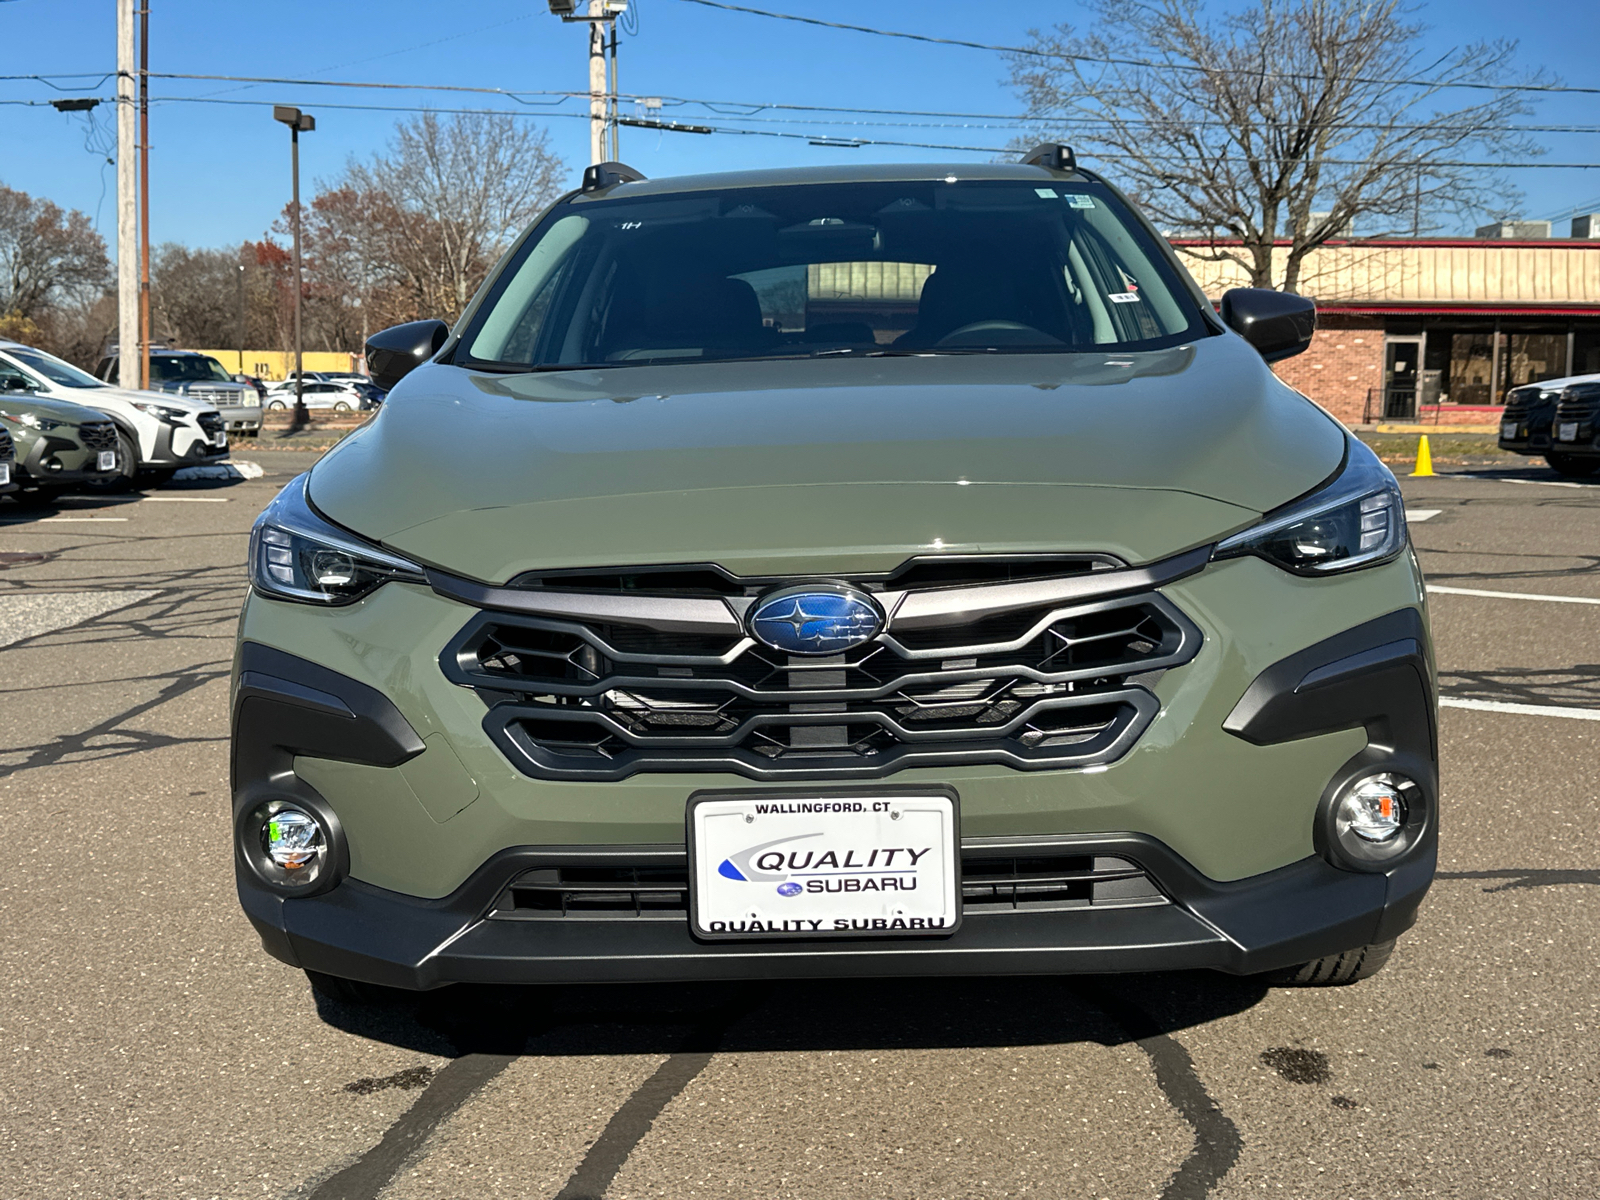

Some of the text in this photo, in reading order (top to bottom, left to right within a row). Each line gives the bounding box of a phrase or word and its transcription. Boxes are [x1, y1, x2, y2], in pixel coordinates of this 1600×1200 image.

[755, 802, 891, 814] WALLINGFORD, CT
[756, 848, 932, 871] QUALITY
[806, 877, 917, 893] SUBARU
[709, 917, 945, 932] QUALITY SUBARU
